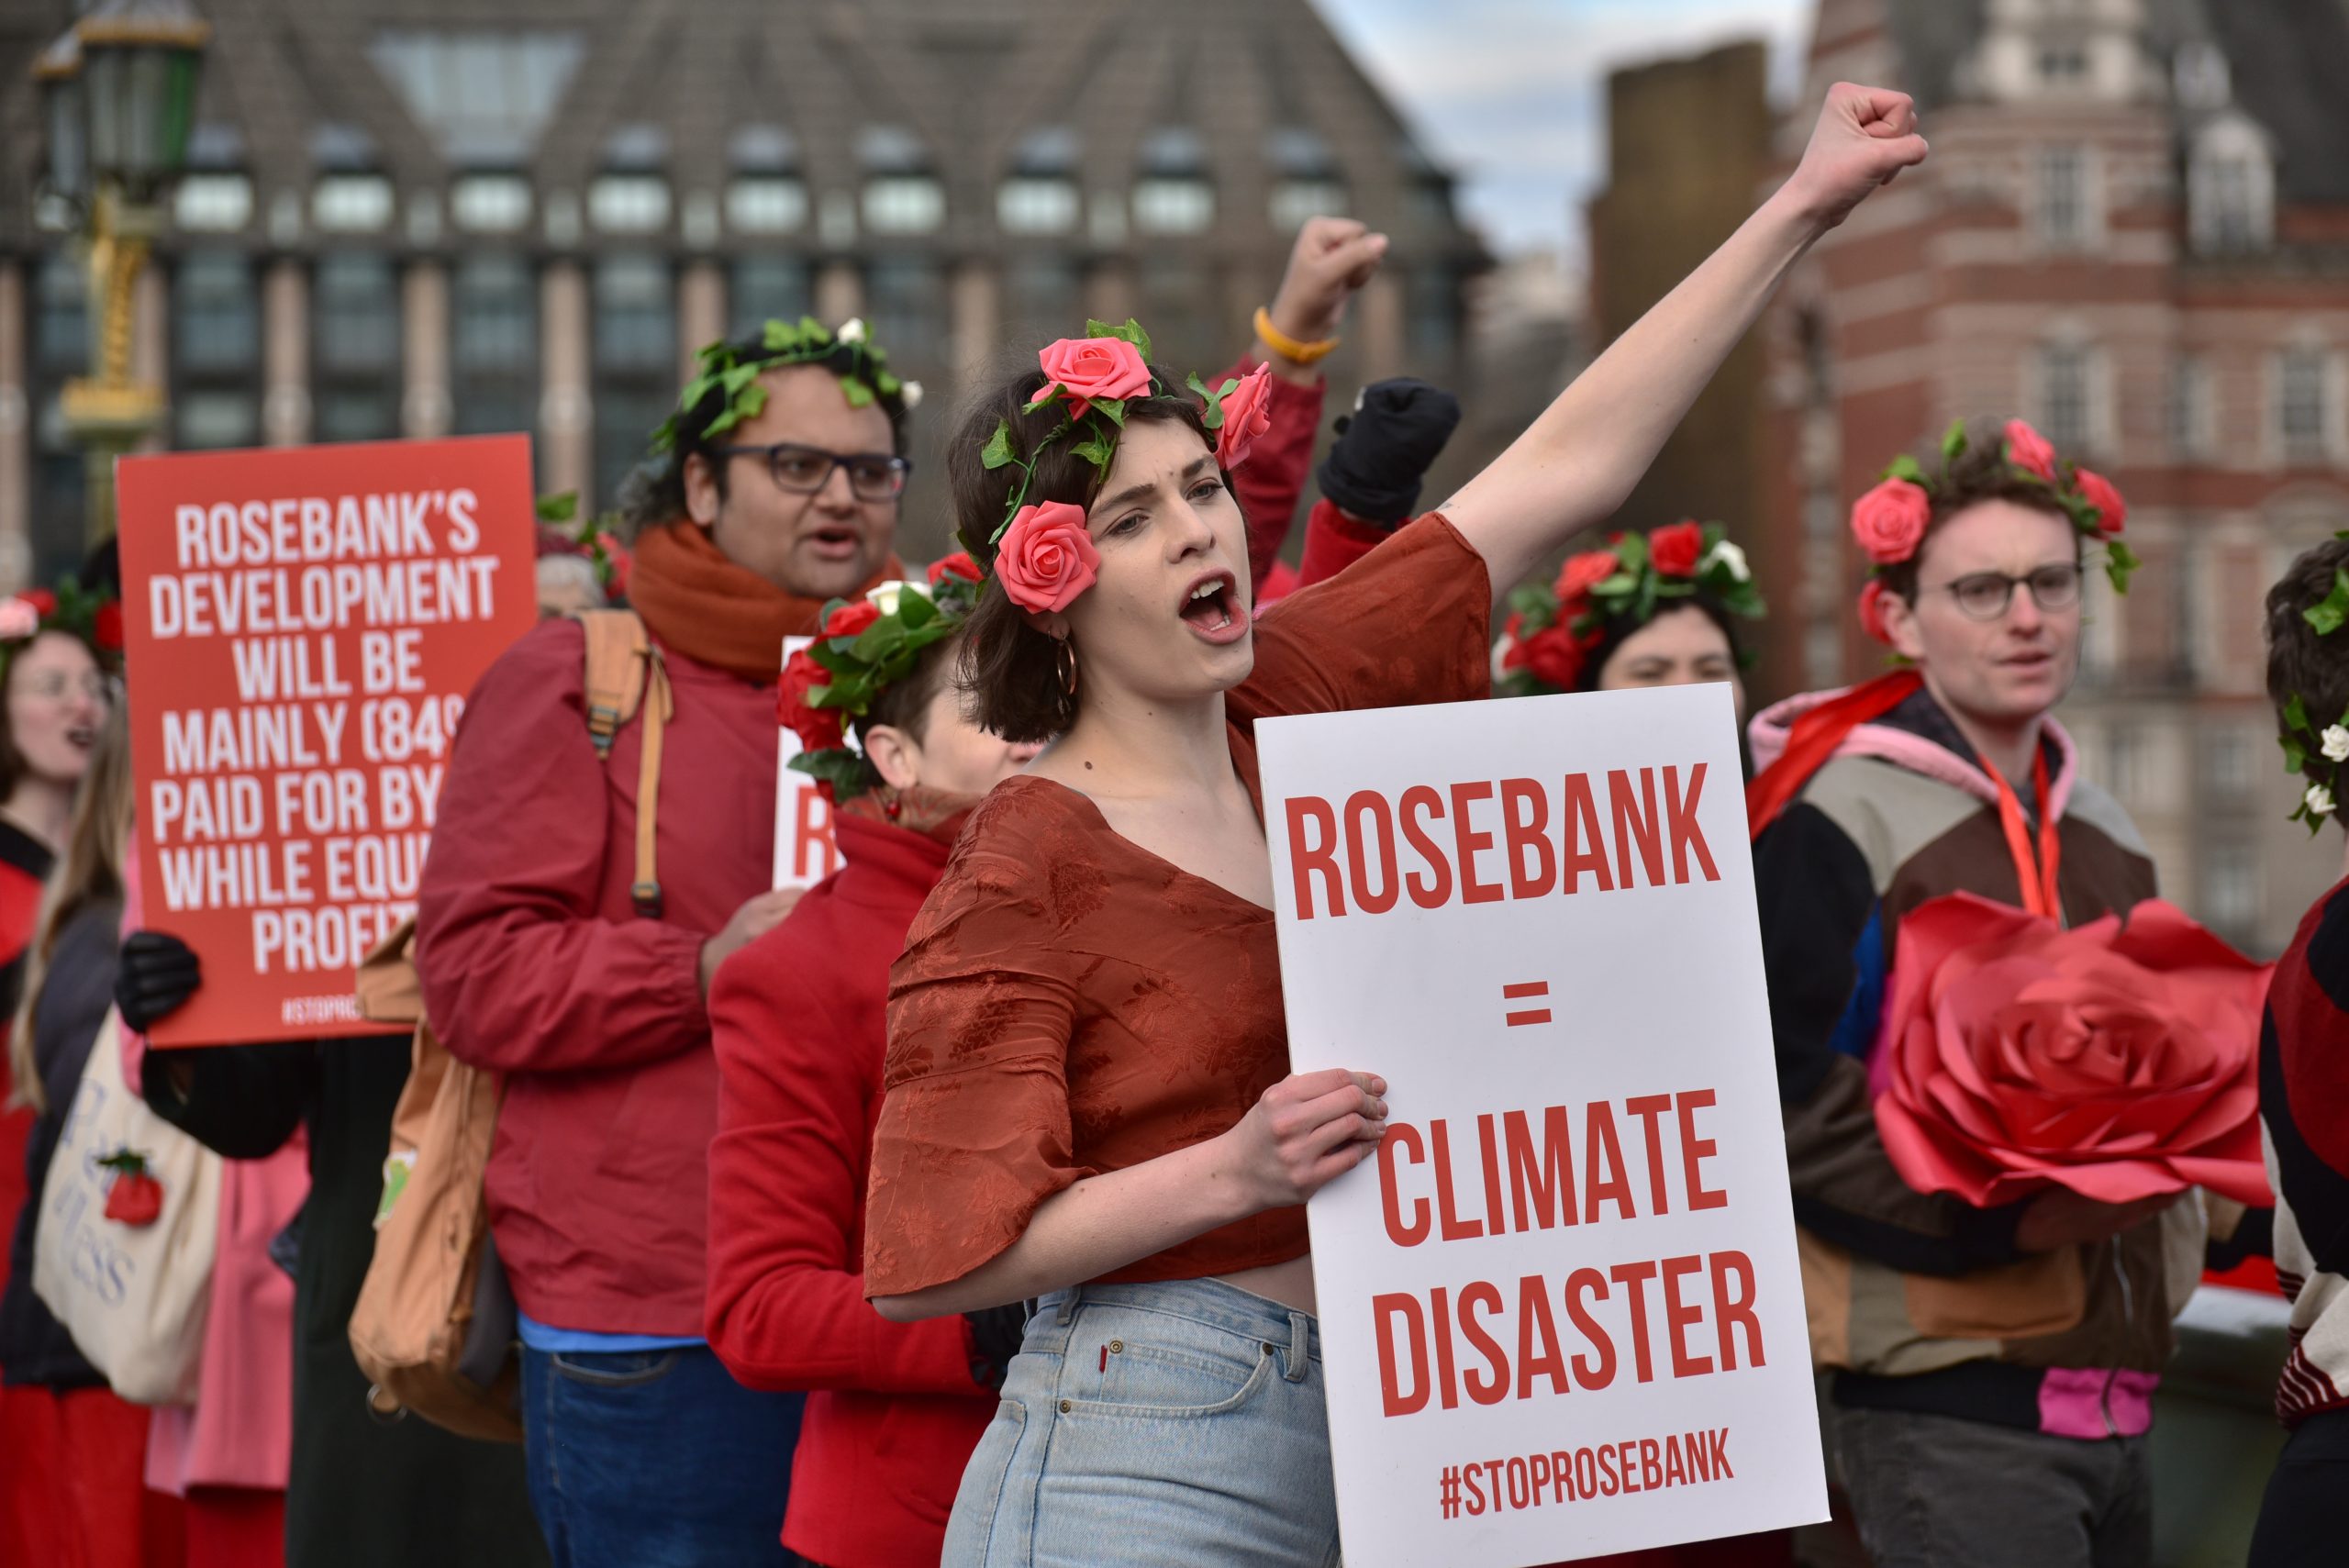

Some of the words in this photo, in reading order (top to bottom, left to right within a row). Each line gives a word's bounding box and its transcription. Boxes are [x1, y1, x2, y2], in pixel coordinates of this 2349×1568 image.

[174, 489, 480, 569] ROSEBANK'S
[149, 556, 500, 638] DEVELOPMENT
[232, 635, 352, 701] WILL
[361, 629, 425, 694] BE
[162, 702, 348, 773] MAINLY
[150, 776, 263, 843] PAID
[275, 770, 369, 835] FOR
[379, 763, 444, 829] BY
[1285, 763, 1721, 921] ROSEBANK
[159, 840, 314, 911] WHILE
[1503, 981, 1553, 1028] =
[1376, 1088, 1729, 1248] CLIMATE
[1372, 1250, 1767, 1418] DISASTER
[1440, 1427, 1735, 1520] #STOPROSEBANK
